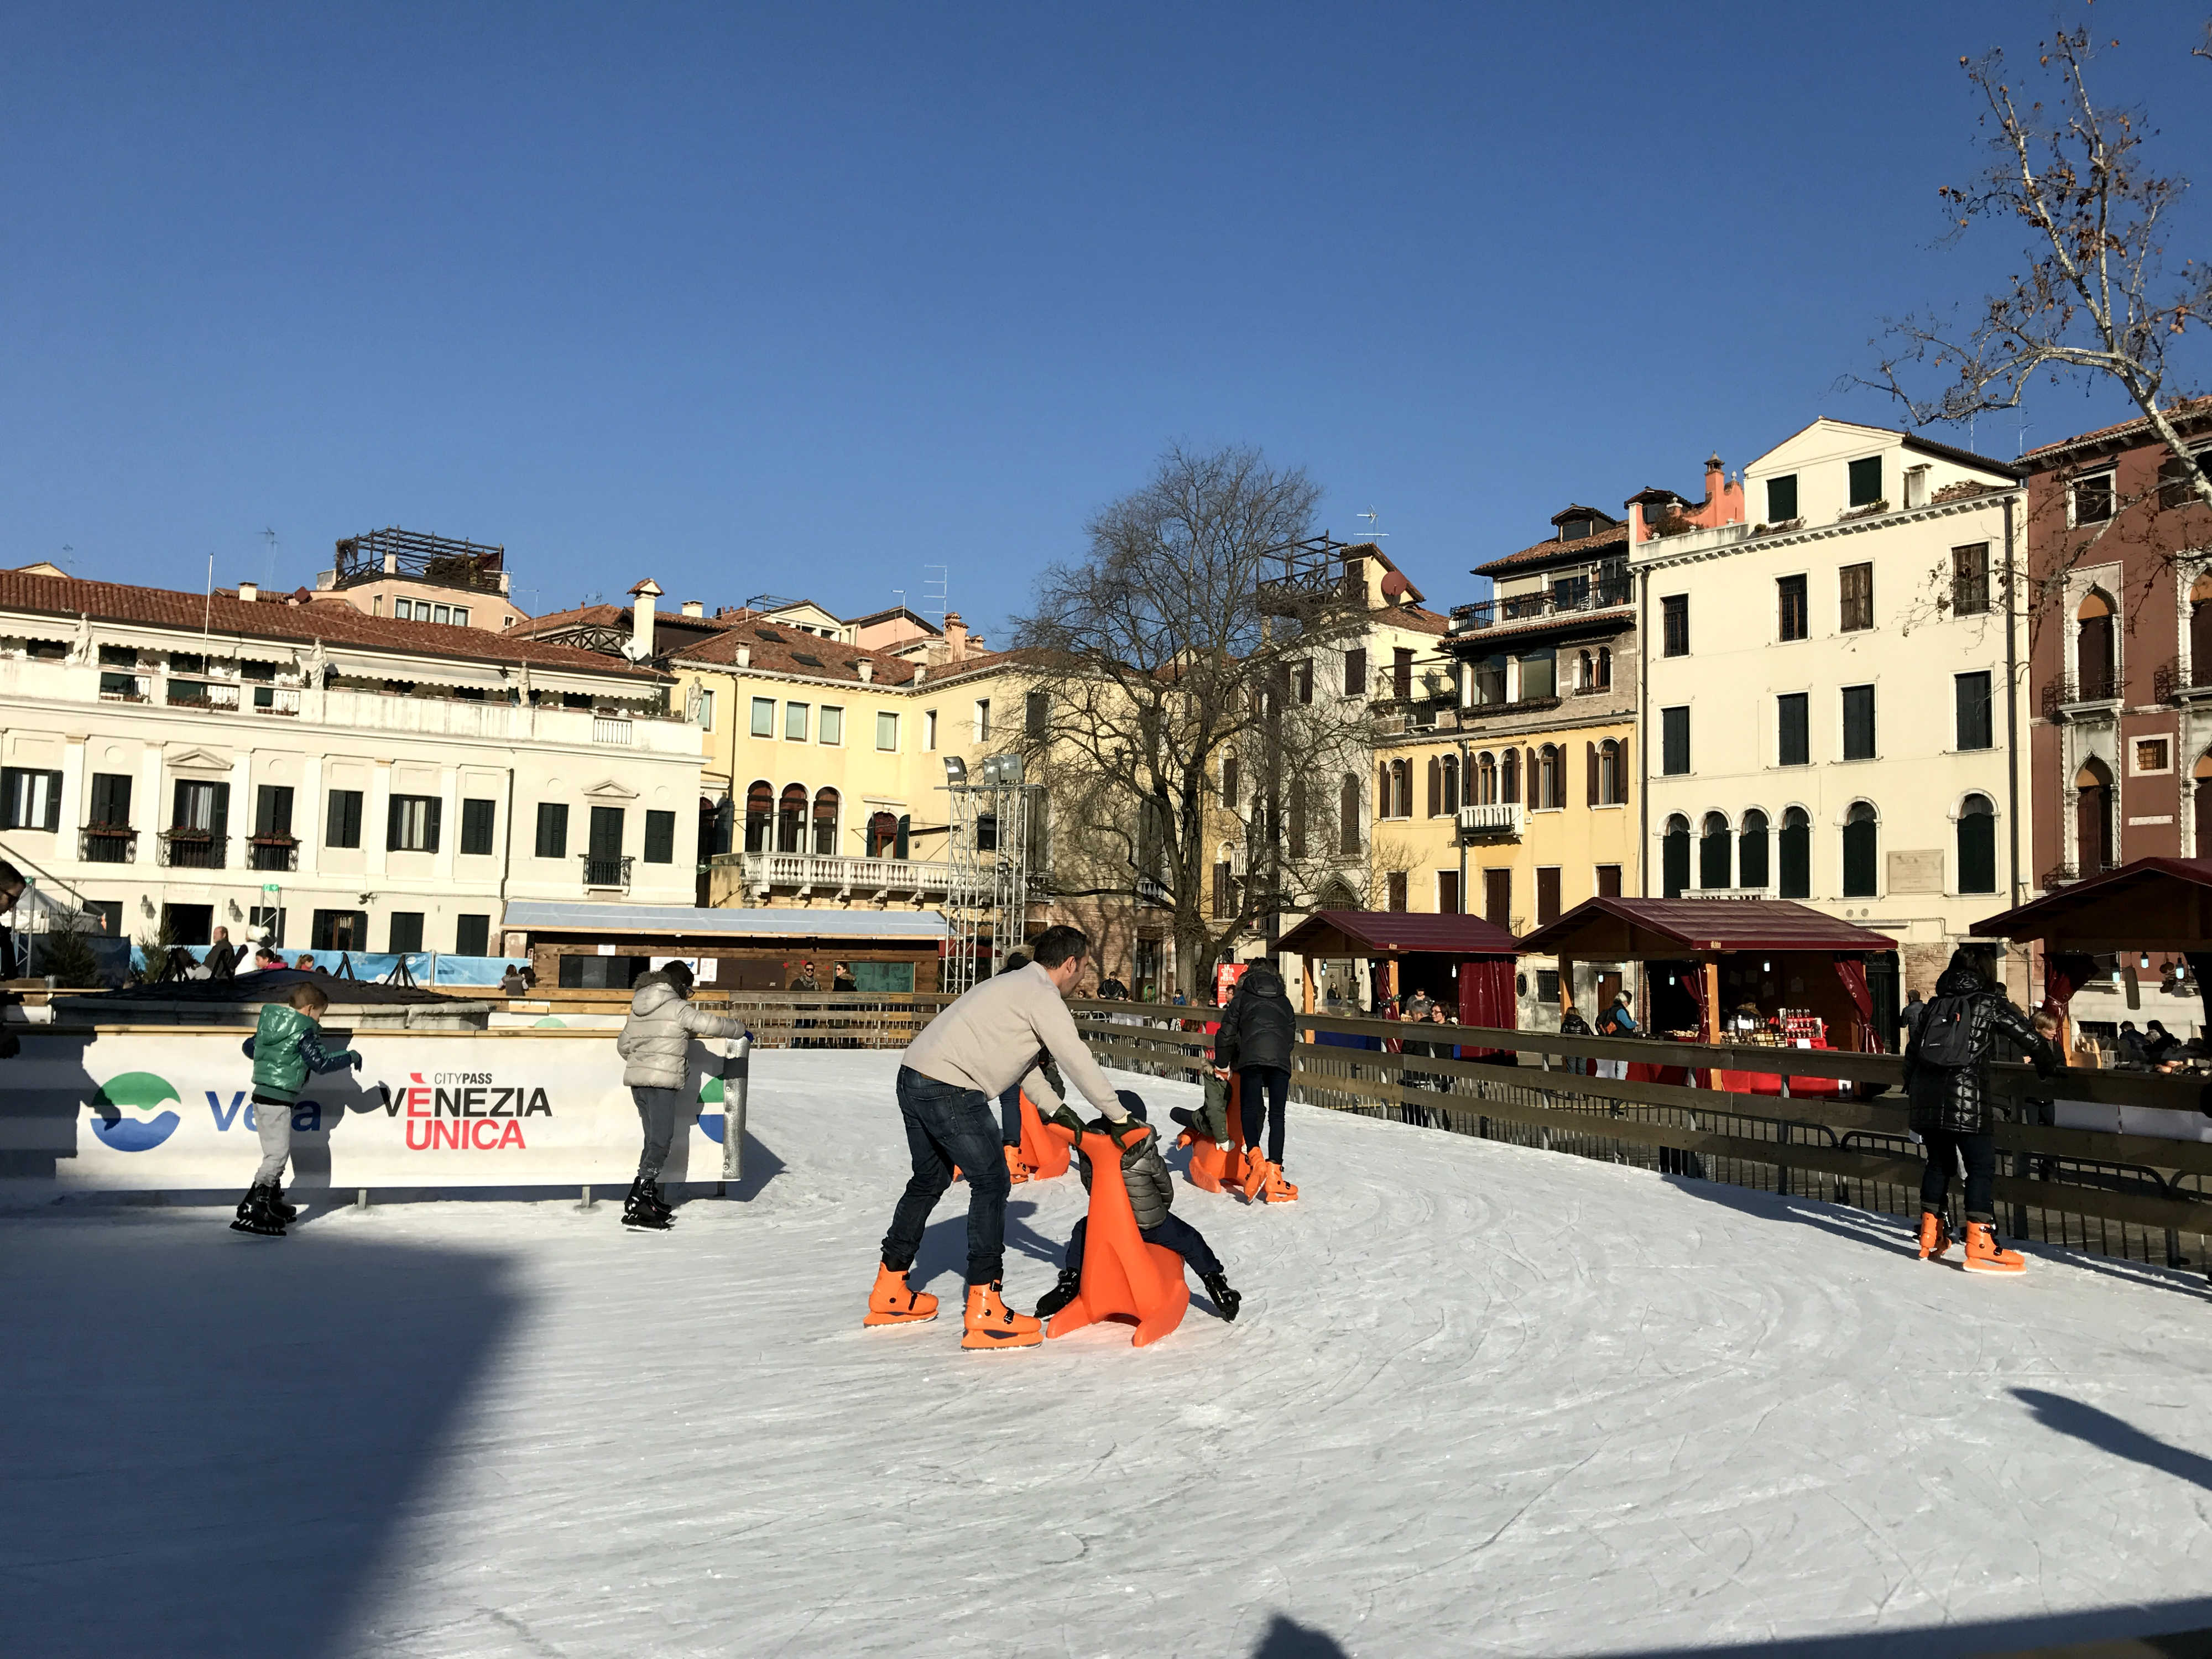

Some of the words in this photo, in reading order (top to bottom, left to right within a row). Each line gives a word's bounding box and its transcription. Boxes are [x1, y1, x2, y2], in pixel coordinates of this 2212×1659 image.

[434, 1073, 493, 1084] CITYPASS
[205, 1091, 321, 1131] Va
[406, 1119, 526, 1150] UNICA
